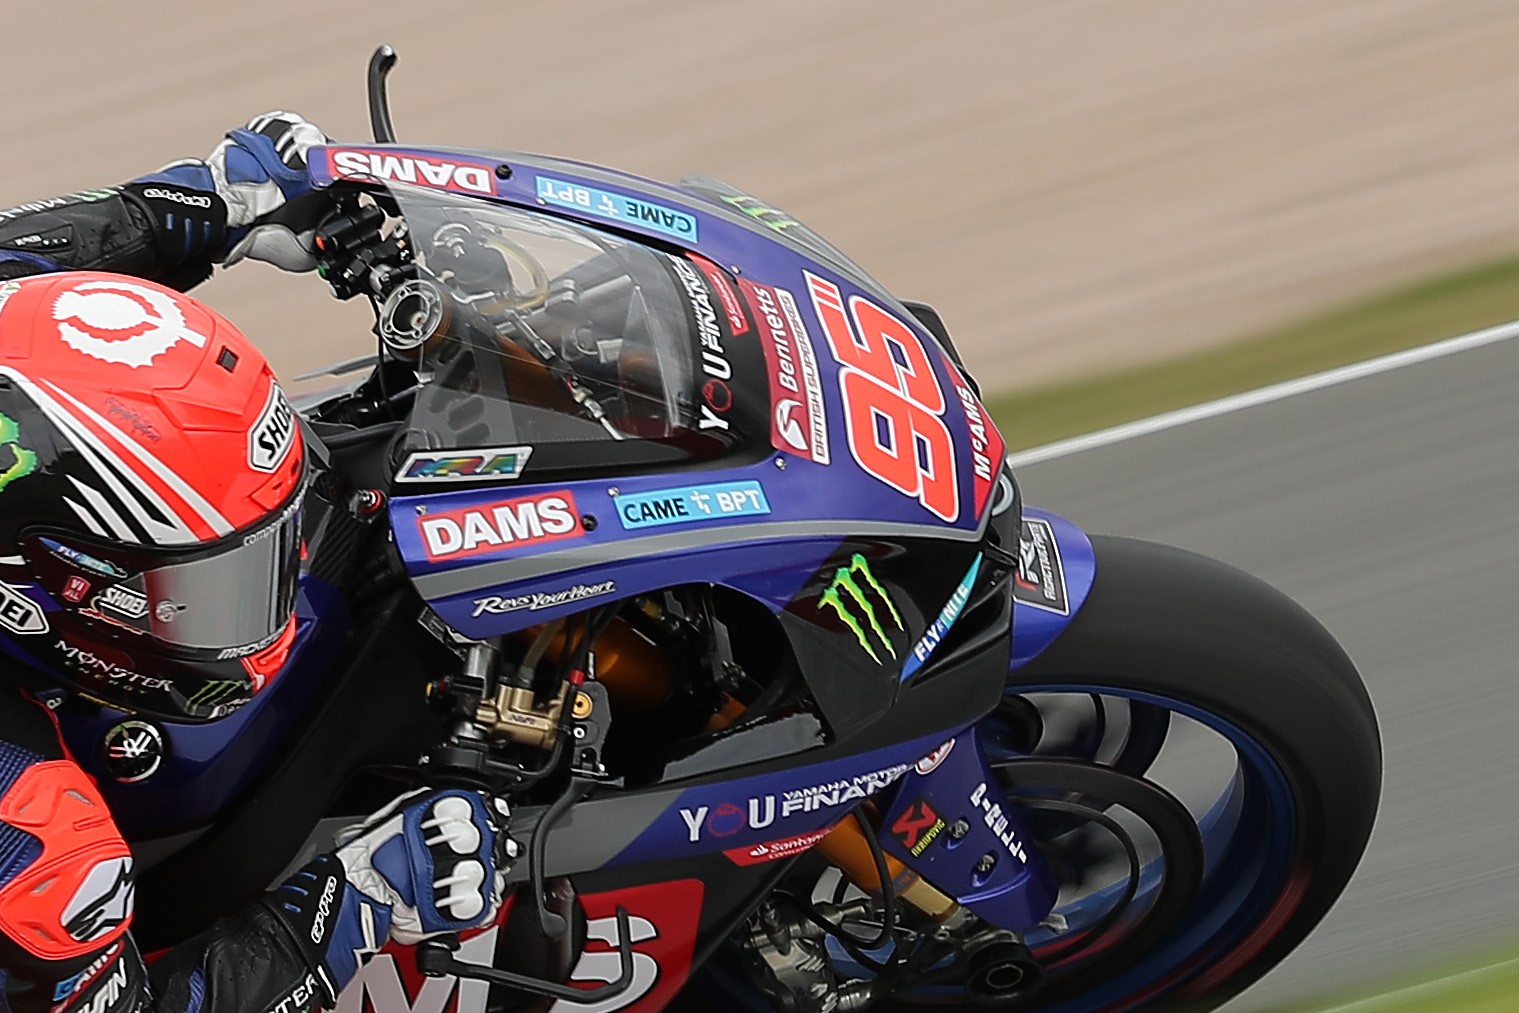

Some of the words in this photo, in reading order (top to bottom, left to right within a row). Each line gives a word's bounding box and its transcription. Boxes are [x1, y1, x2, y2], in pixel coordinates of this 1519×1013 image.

[332, 150, 493, 194] DAMS
[542, 180, 591, 204] BPT
[626, 200, 692, 233] CAME
[753, 286, 799, 392] Bennetts
[258, 391, 292, 461] SHO
[802, 269, 959, 524] 95
[806, 391, 828, 457] BRITISH
[956, 384, 992, 482] McAMS
[421, 497, 576, 556] DAMS
[623, 498, 690, 523] CAME
[719, 488, 762, 513] BPT
[913, 624, 942, 663] FLY
[943, 583, 970, 622] NITE
[783, 781, 849, 800] YAMAHA
